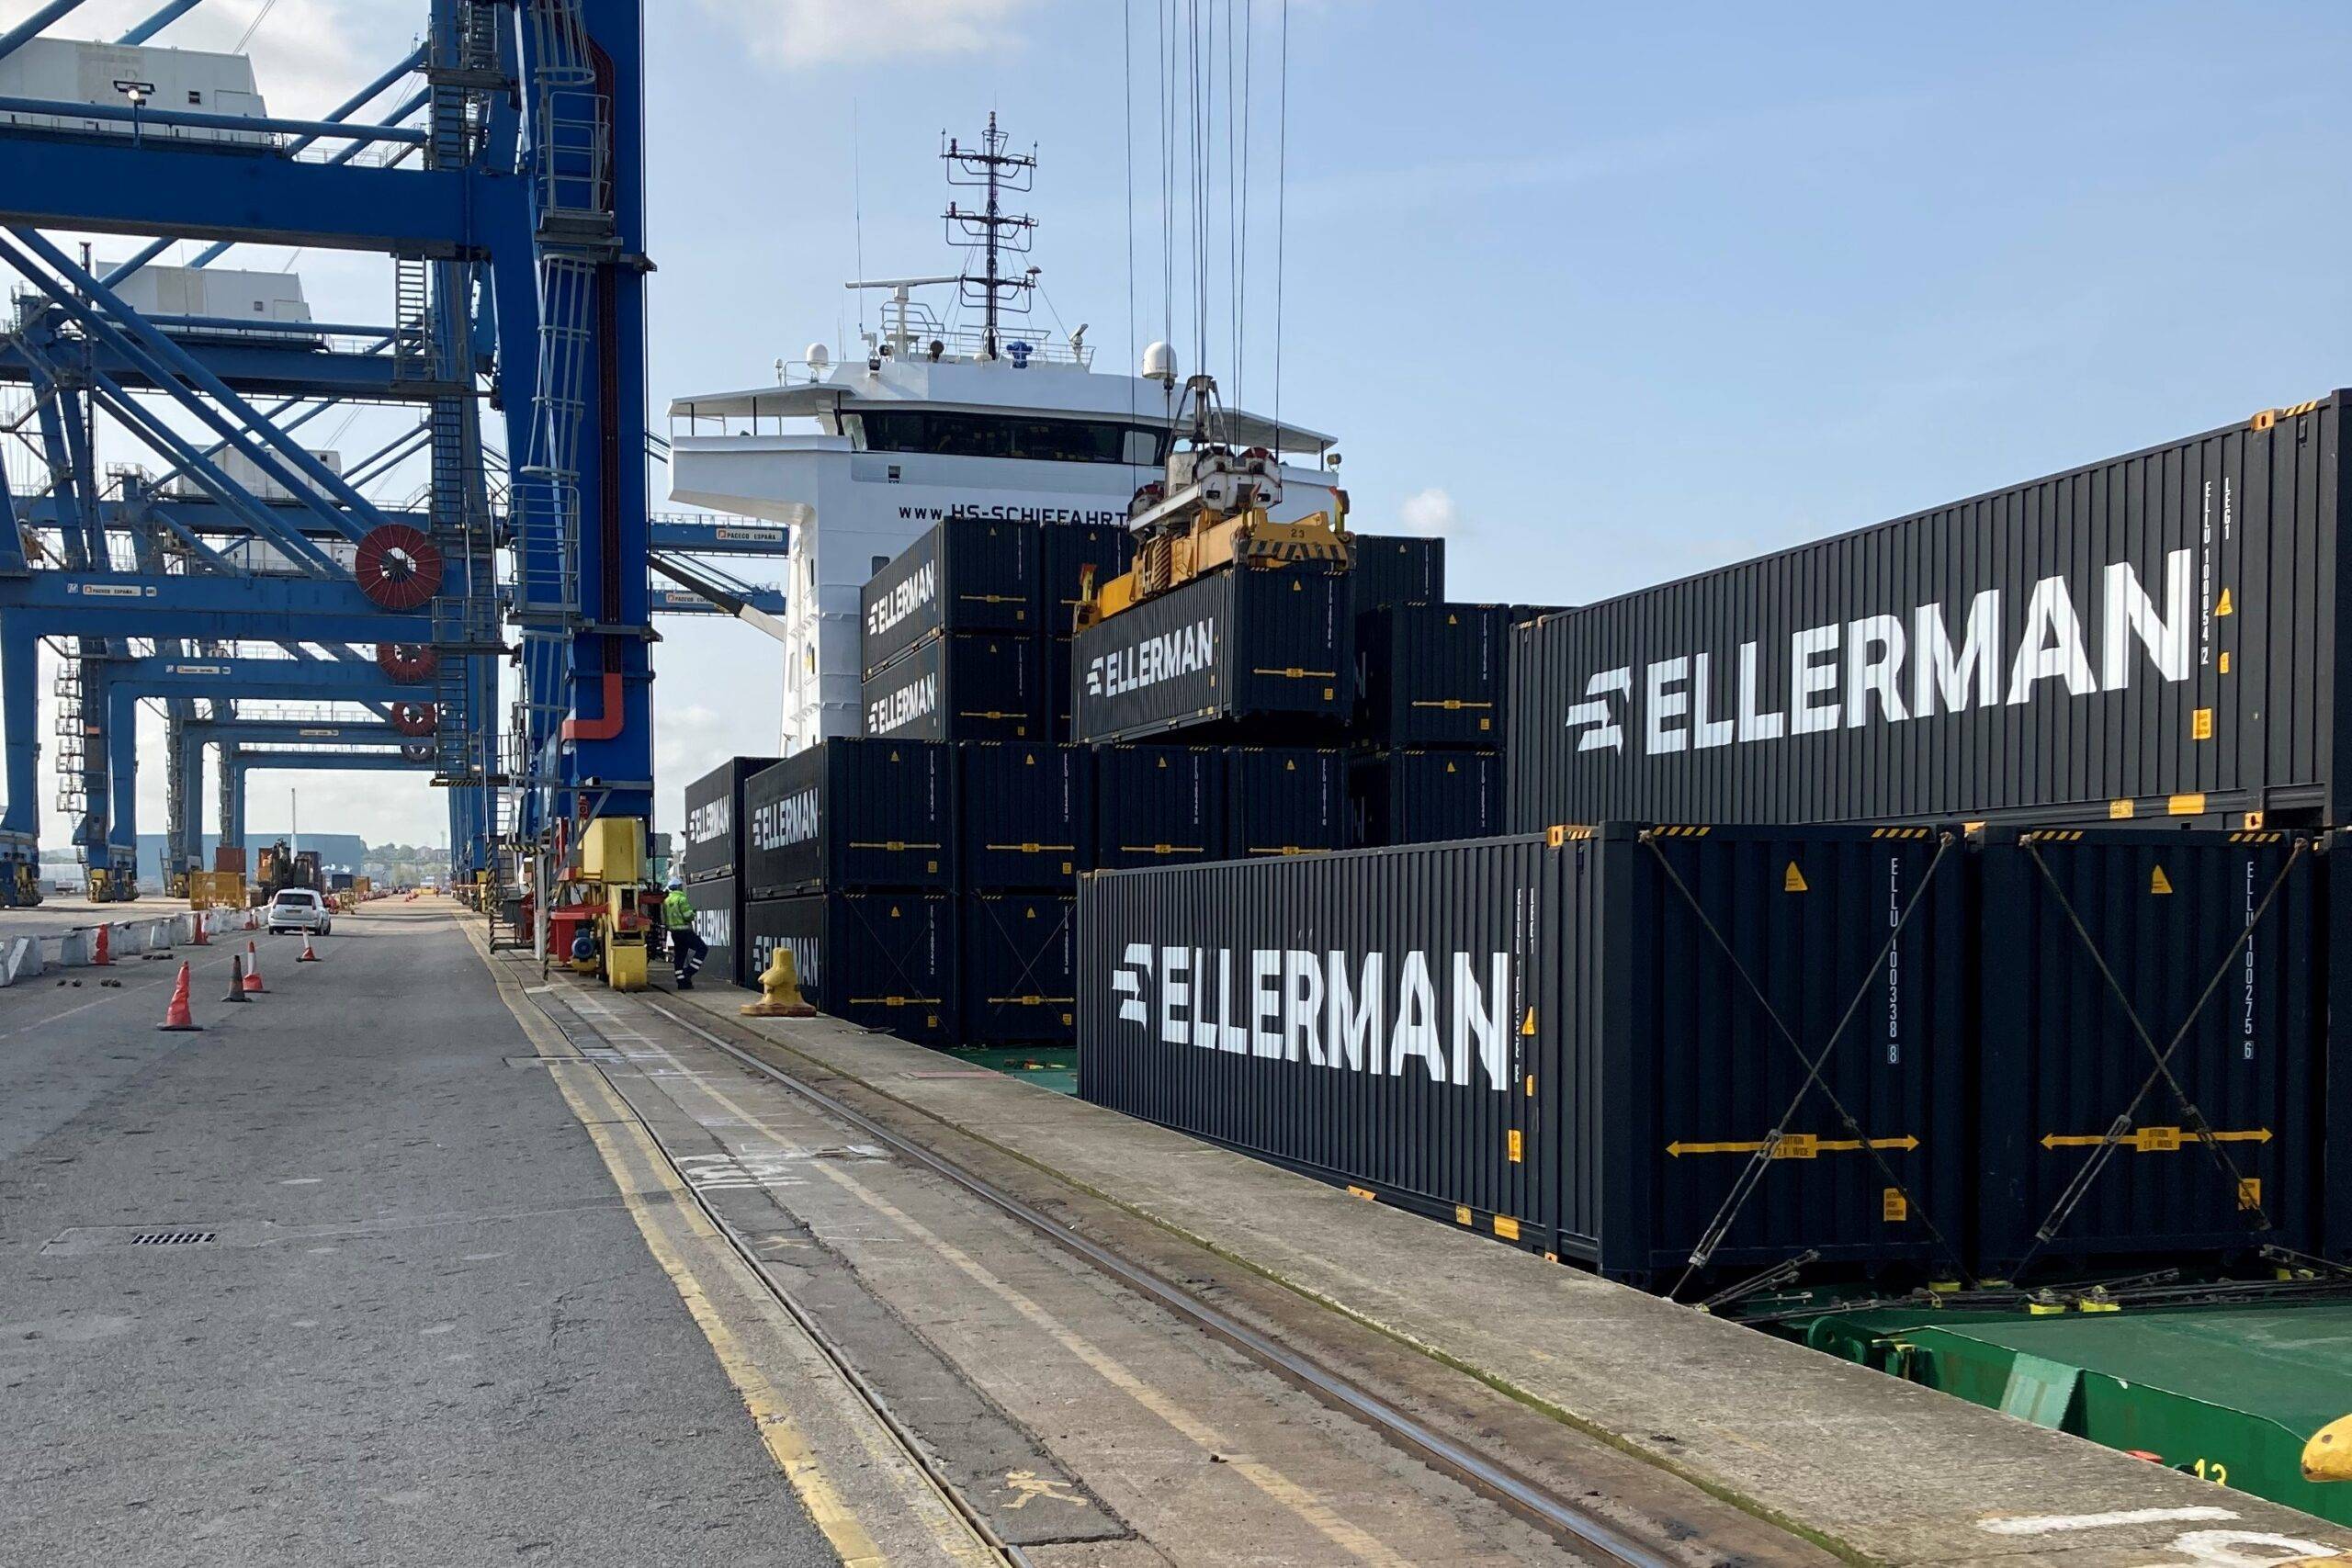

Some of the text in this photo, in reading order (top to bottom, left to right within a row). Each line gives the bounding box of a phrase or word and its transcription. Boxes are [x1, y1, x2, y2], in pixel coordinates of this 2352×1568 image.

[1290, 528, 1305, 538] 23
[2203, 480, 2212, 544] ELLU
[878, 559, 934, 635] ELLERMAN
[1106, 617, 1214, 698] ELLERMAN
[1646, 548, 2191, 756] ELLERMAN
[878, 672, 935, 735] ELLERMAN
[695, 795, 729, 844] ELLERMAN
[763, 787, 819, 851] ELLERMAN
[1889, 857, 1899, 928] ELLU
[763, 936, 819, 987] ELMAN
[1889, 937, 1898, 1039] 100338
[2245, 934, 2254, 1035] 100275
[1162, 946, 1508, 1091] ELLERMAN
